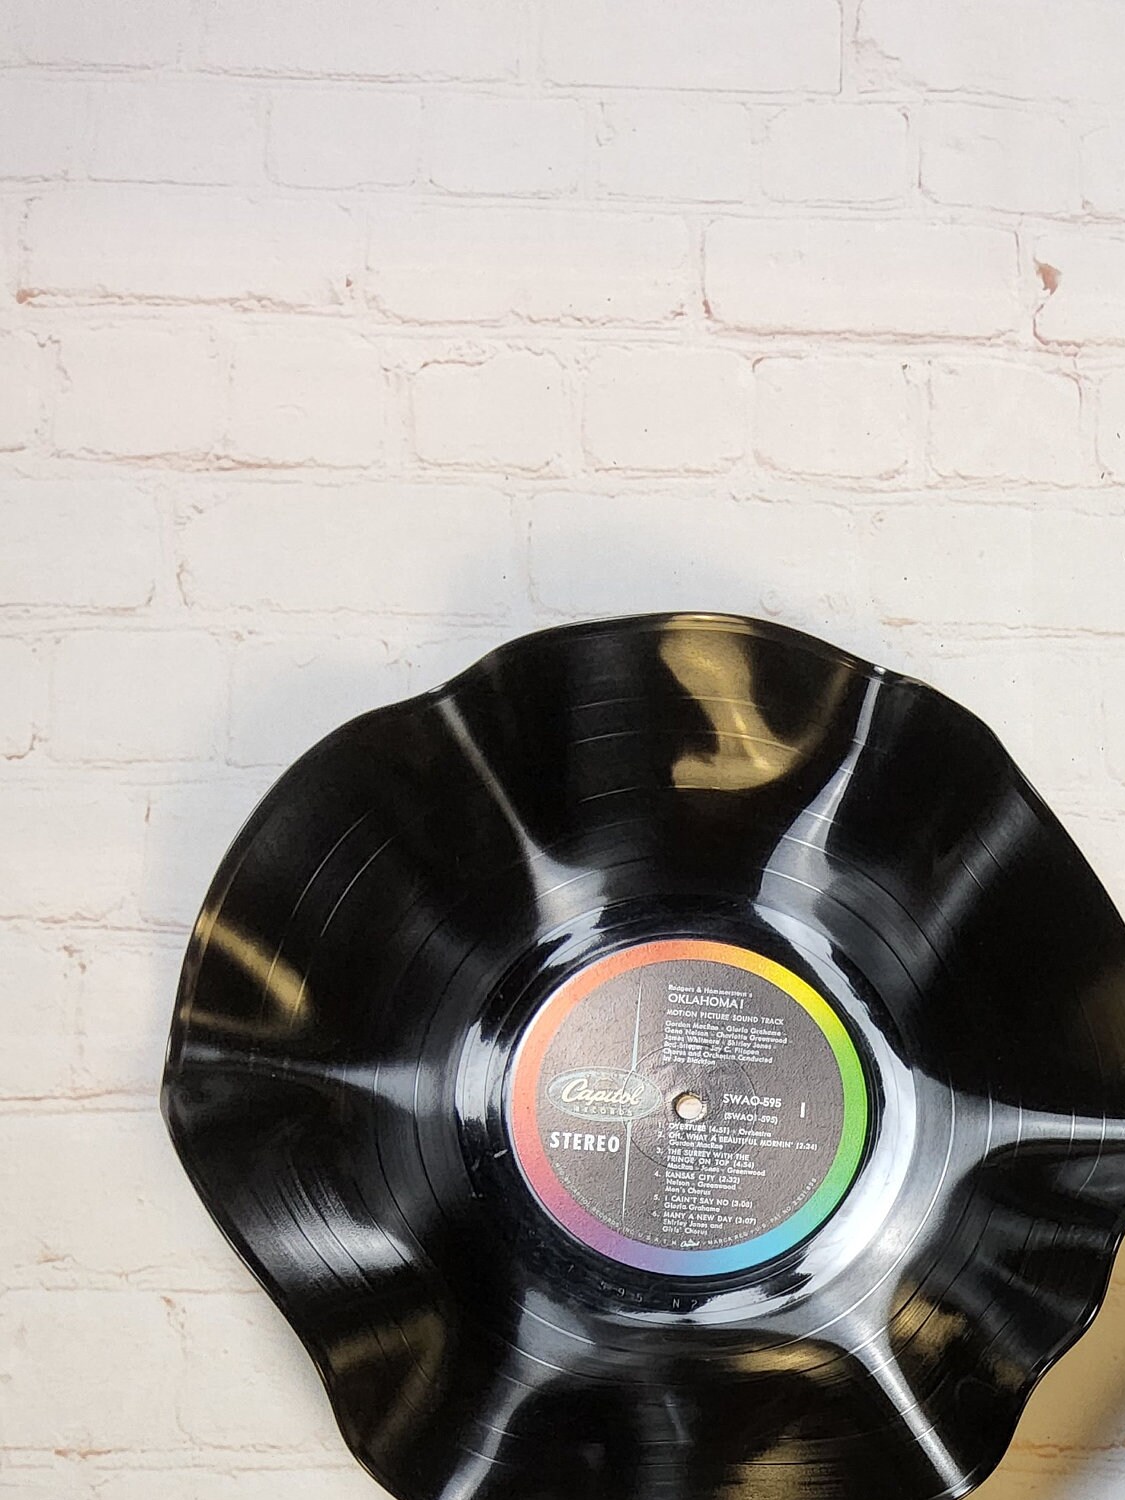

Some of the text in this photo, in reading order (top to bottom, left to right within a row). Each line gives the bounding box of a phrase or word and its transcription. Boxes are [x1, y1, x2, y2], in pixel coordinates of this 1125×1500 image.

[666, 1009, 784, 1026] MOTION PICTURE SOUND TRACK
[665, 1020, 690, 1028] Gordon
[726, 1025, 749, 1034] Gloria
[727, 1039, 751, 1048] Shirley
[738, 1054, 773, 1063] Conducted
[561, 1078, 645, 1105] Capitol
[669, 1123, 706, 1132] OVERTURE
[550, 1131, 620, 1152] STEREO
[686, 1132, 708, 1141] WHAT
[719, 1136, 757, 1146] BEAUTIFUL
[669, 1140, 723, 1150] Gordon MacRae
[668, 1148, 682, 1156] THE
[683, 1149, 710, 1158] SURREY
[713, 1151, 733, 1160] WITH
[736, 1153, 750, 1161] THE
[667, 1156, 694, 1164] FRINGE
[698, 1157, 711, 1165] ON
[714, 1158, 730, 1167] TOP
[666, 1171, 695, 1180] KANSAS
[698, 1174, 716, 1182] CITY
[727, 1167, 766, 1176] Greenwood
[666, 1178, 736, 1190] Nelson Greenwood
[665, 1186, 711, 1196] Men's Chorus
[671, 1195, 698, 1204] CAIN'T
[688, 1204, 720, 1213] Grahame
[663, 1210, 686, 1219] MANY
[696, 1214, 715, 1222] NEW
[717, 1215, 733, 1223] DAY
[663, 1218, 687, 1227] Shirley
[684, 1227, 708, 1236] Chorus
